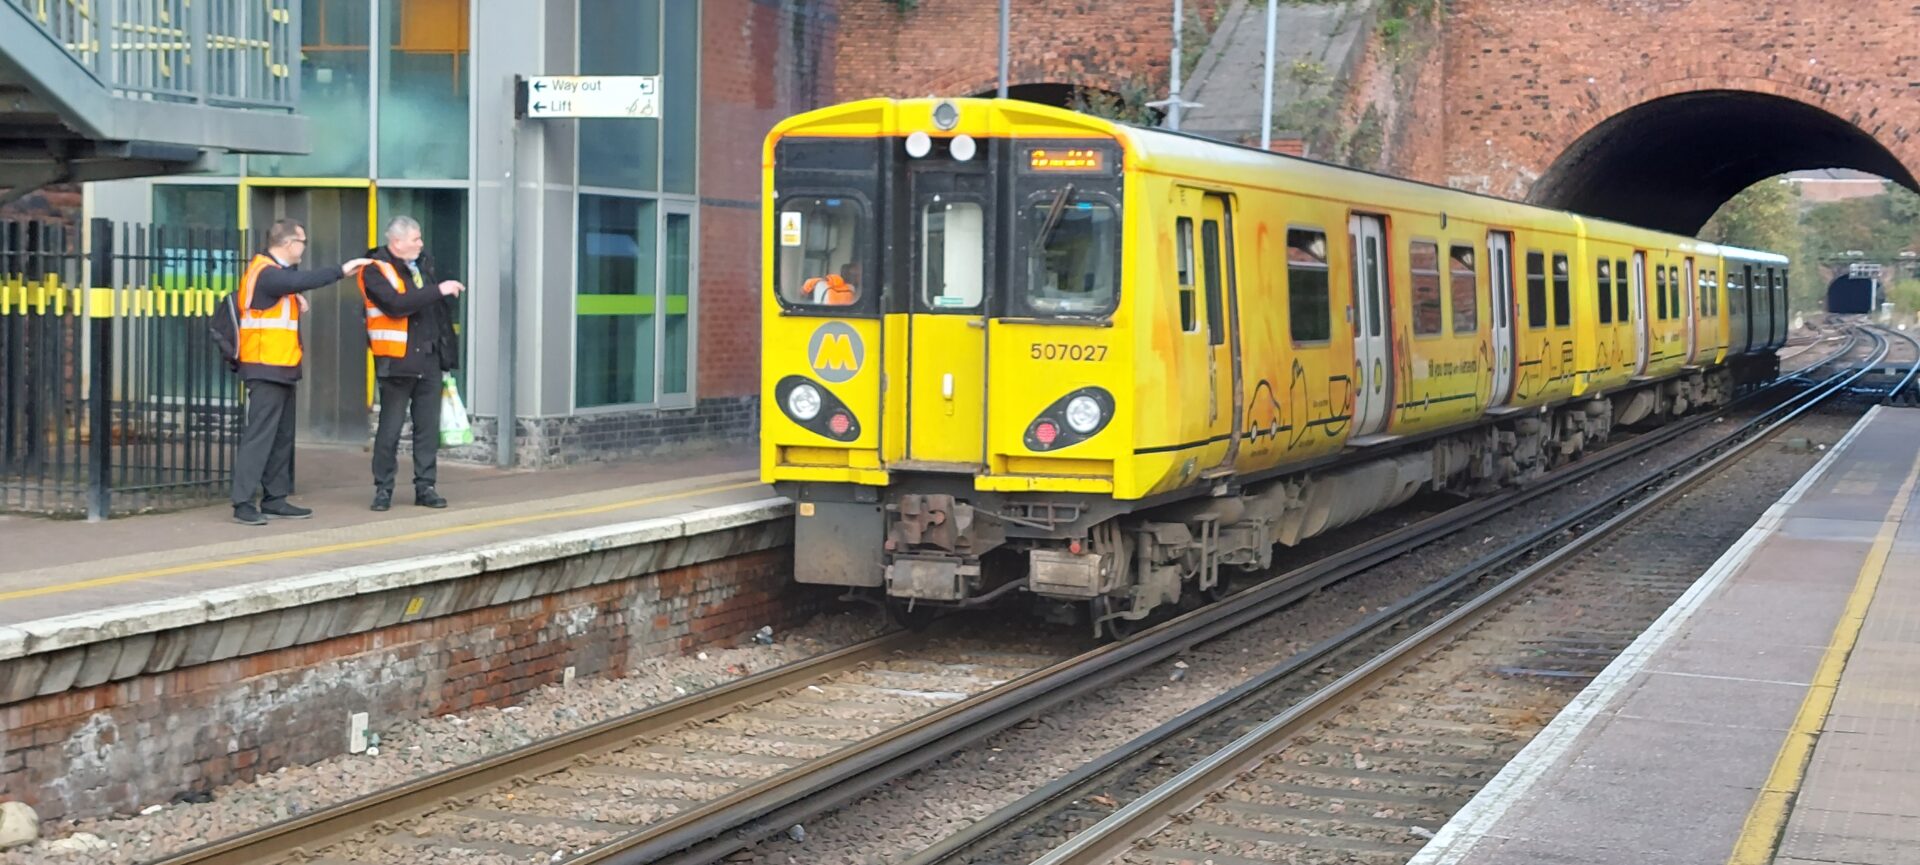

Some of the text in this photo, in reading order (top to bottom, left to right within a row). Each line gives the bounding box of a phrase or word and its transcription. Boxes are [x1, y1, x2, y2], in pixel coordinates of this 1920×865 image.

[552, 79, 602, 93] Way out
[551, 100, 572, 112] Lift
[813, 332, 858, 371] M
[1030, 343, 1108, 361] 507027
